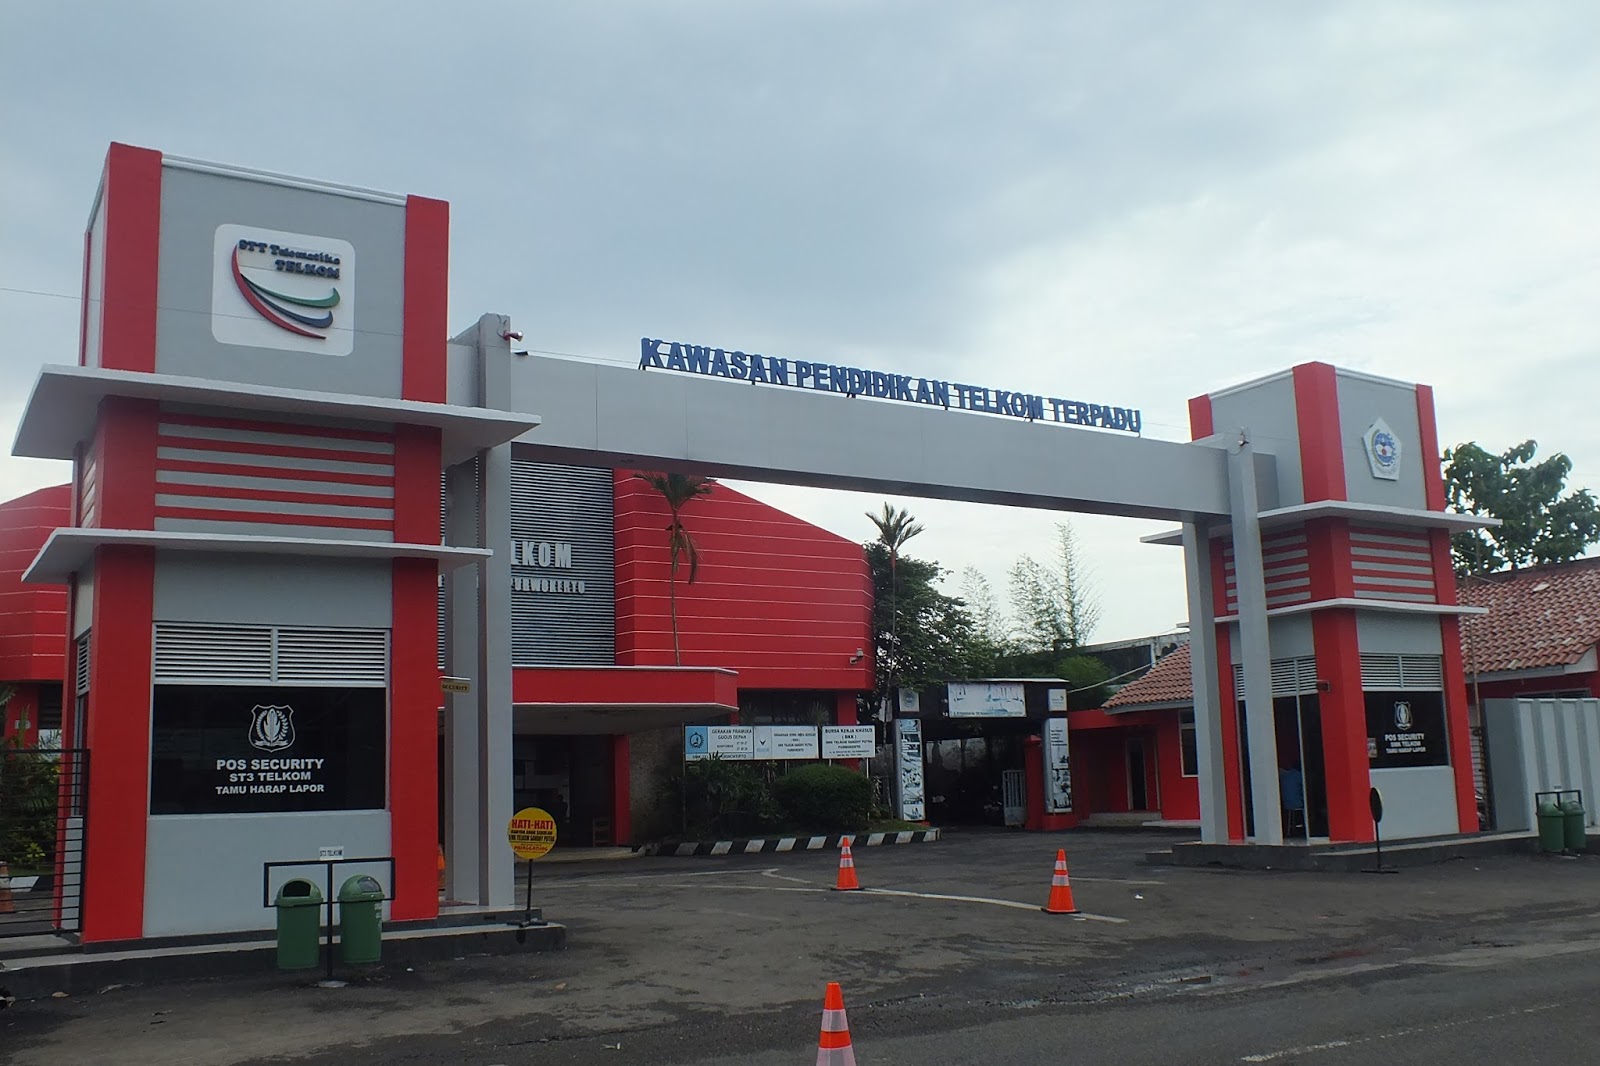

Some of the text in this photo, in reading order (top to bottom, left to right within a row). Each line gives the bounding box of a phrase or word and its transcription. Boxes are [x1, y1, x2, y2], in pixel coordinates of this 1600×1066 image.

[238, 238, 341, 265] STT Telematika
[274, 259, 341, 279] TELKOM
[641, 337, 1142, 433] KAWASAN PENDIDIKAN TELKOM TERPADU
[1384, 732, 1425, 741] POS SECURITY
[216, 758, 325, 771] POS SECURITY
[229, 771, 311, 782] ST3 TELKOM
[215, 784, 325, 795] TAMU HARAP LAPOR
[511, 819, 554, 830] HATI-HATI
